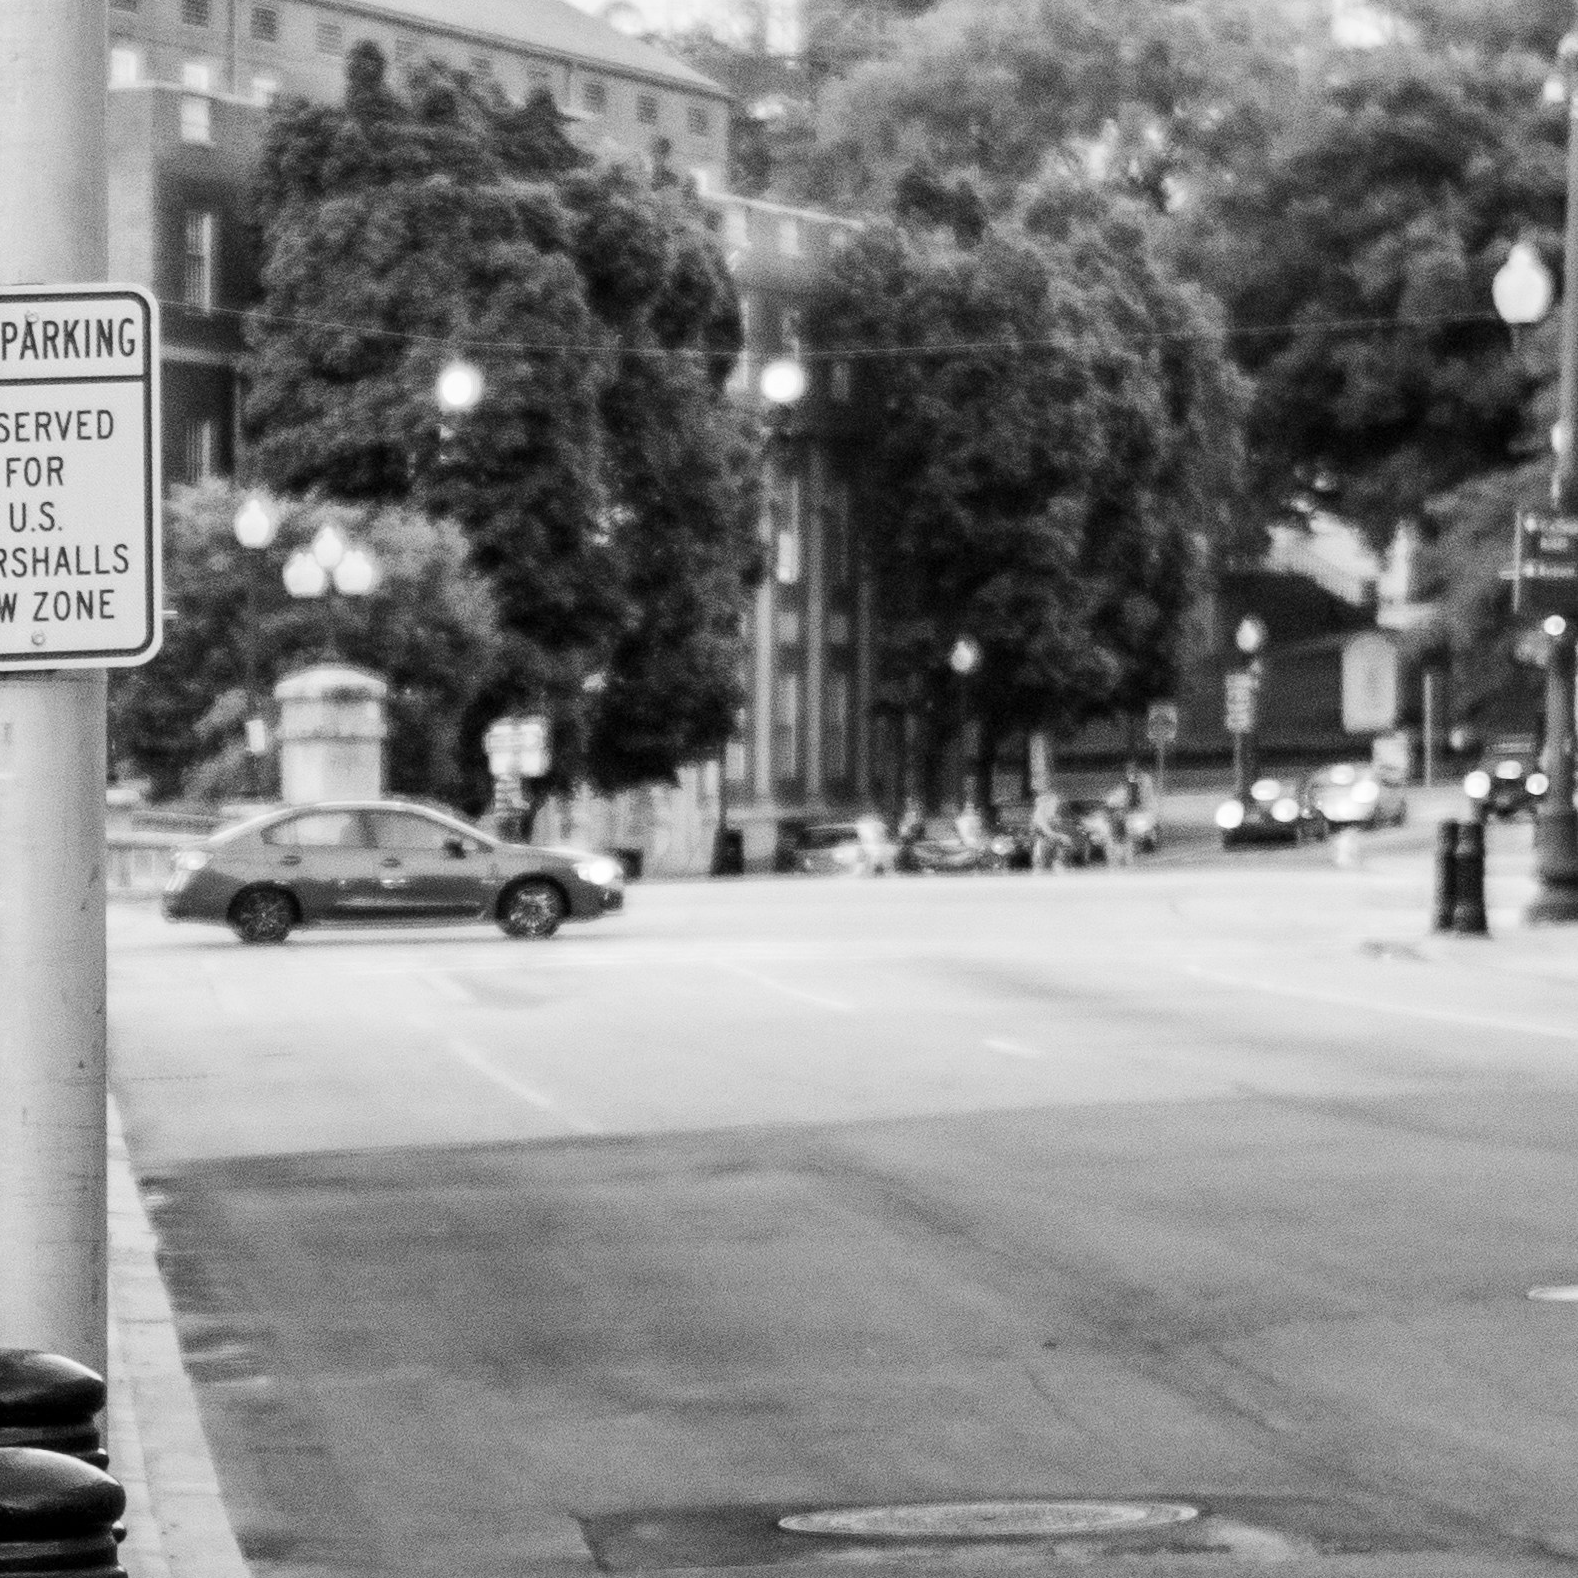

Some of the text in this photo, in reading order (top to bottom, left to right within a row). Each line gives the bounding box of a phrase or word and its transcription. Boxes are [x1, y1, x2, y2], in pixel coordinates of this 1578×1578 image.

[0, 318, 137, 360] PARKING
[5, 456, 65, 488] FOR
[9, 502, 63, 532] U.S.
[32, 589, 116, 622] ZONE
